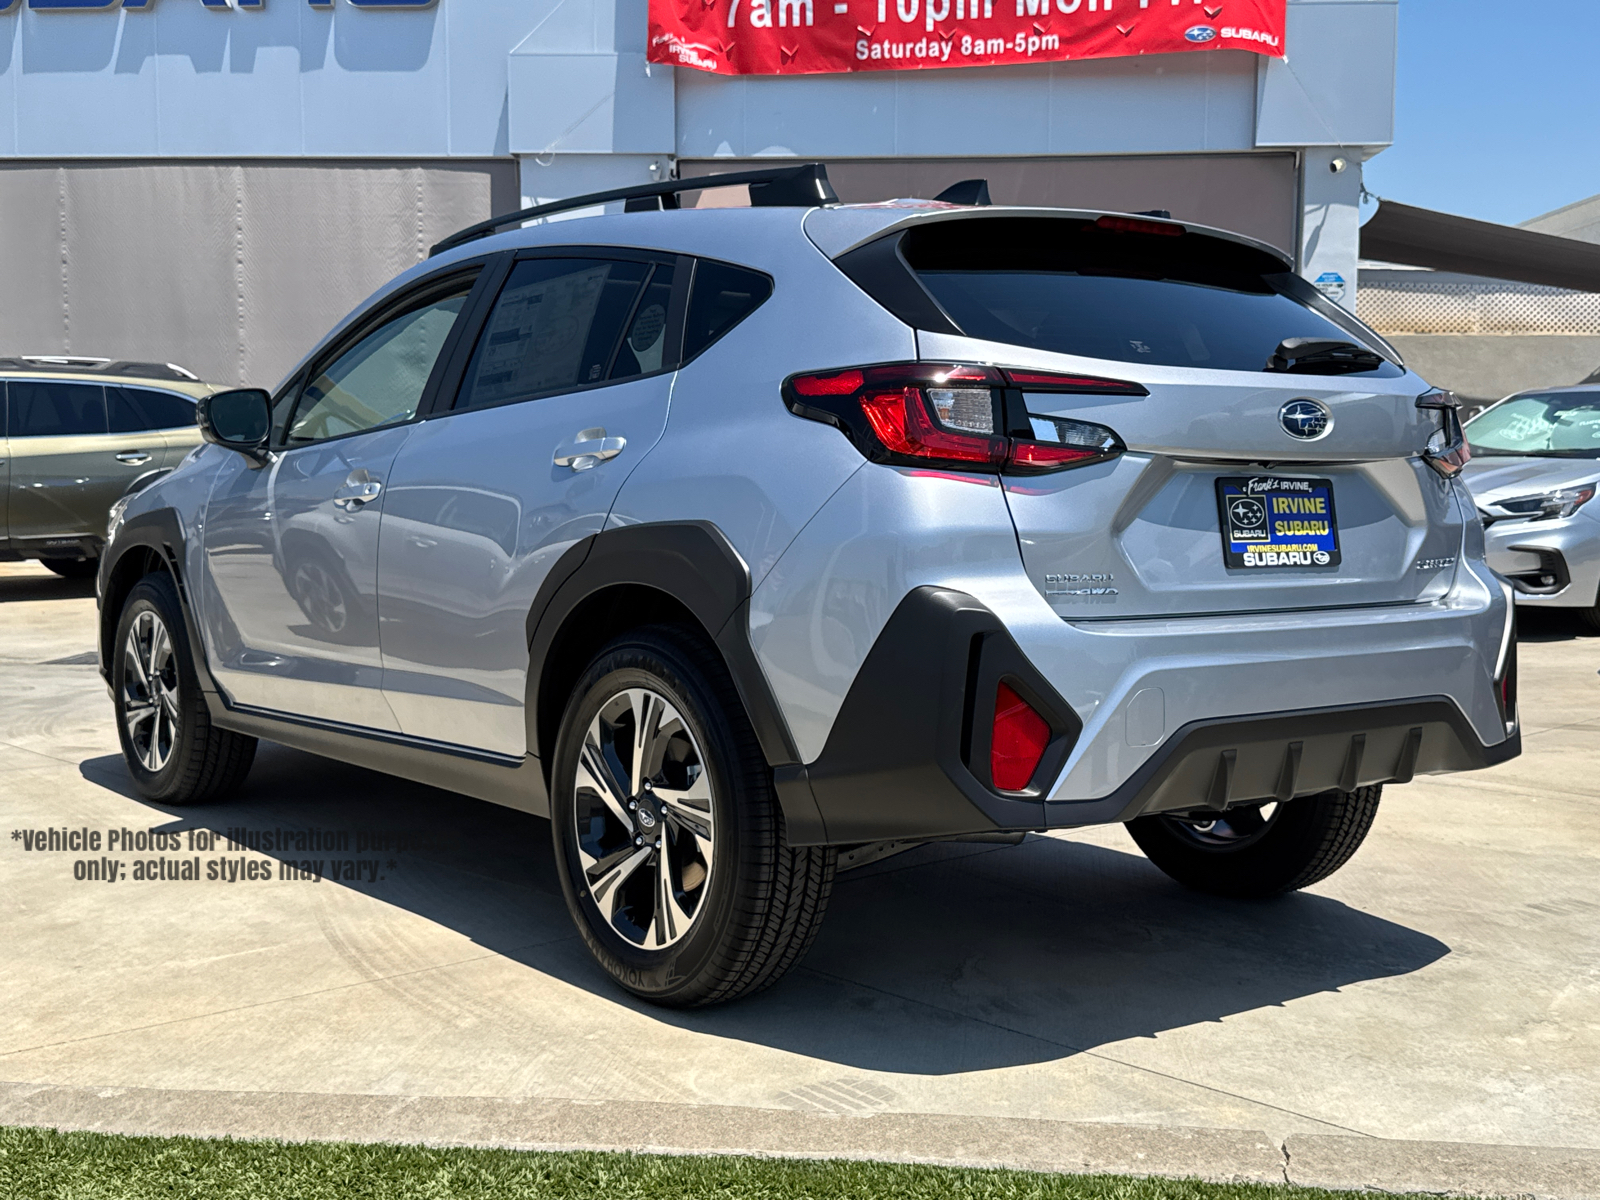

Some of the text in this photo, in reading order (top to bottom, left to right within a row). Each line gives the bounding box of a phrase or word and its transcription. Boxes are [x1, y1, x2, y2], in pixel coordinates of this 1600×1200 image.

[1220, 27, 1279, 47] SUBARU
[856, 33, 1060, 61] Saturday 8am-5pm
[1280, 481, 1310, 491] IRVINE
[1272, 497, 1327, 514] IRVINE
[1233, 529, 1267, 538] SUBARU
[1274, 520, 1330, 537] SUBARU
[1246, 543, 1319, 553] IRVINESUBARU.COM
[1242, 551, 1312, 567] SUBARU
[1045, 573, 1115, 584] SUBARU
